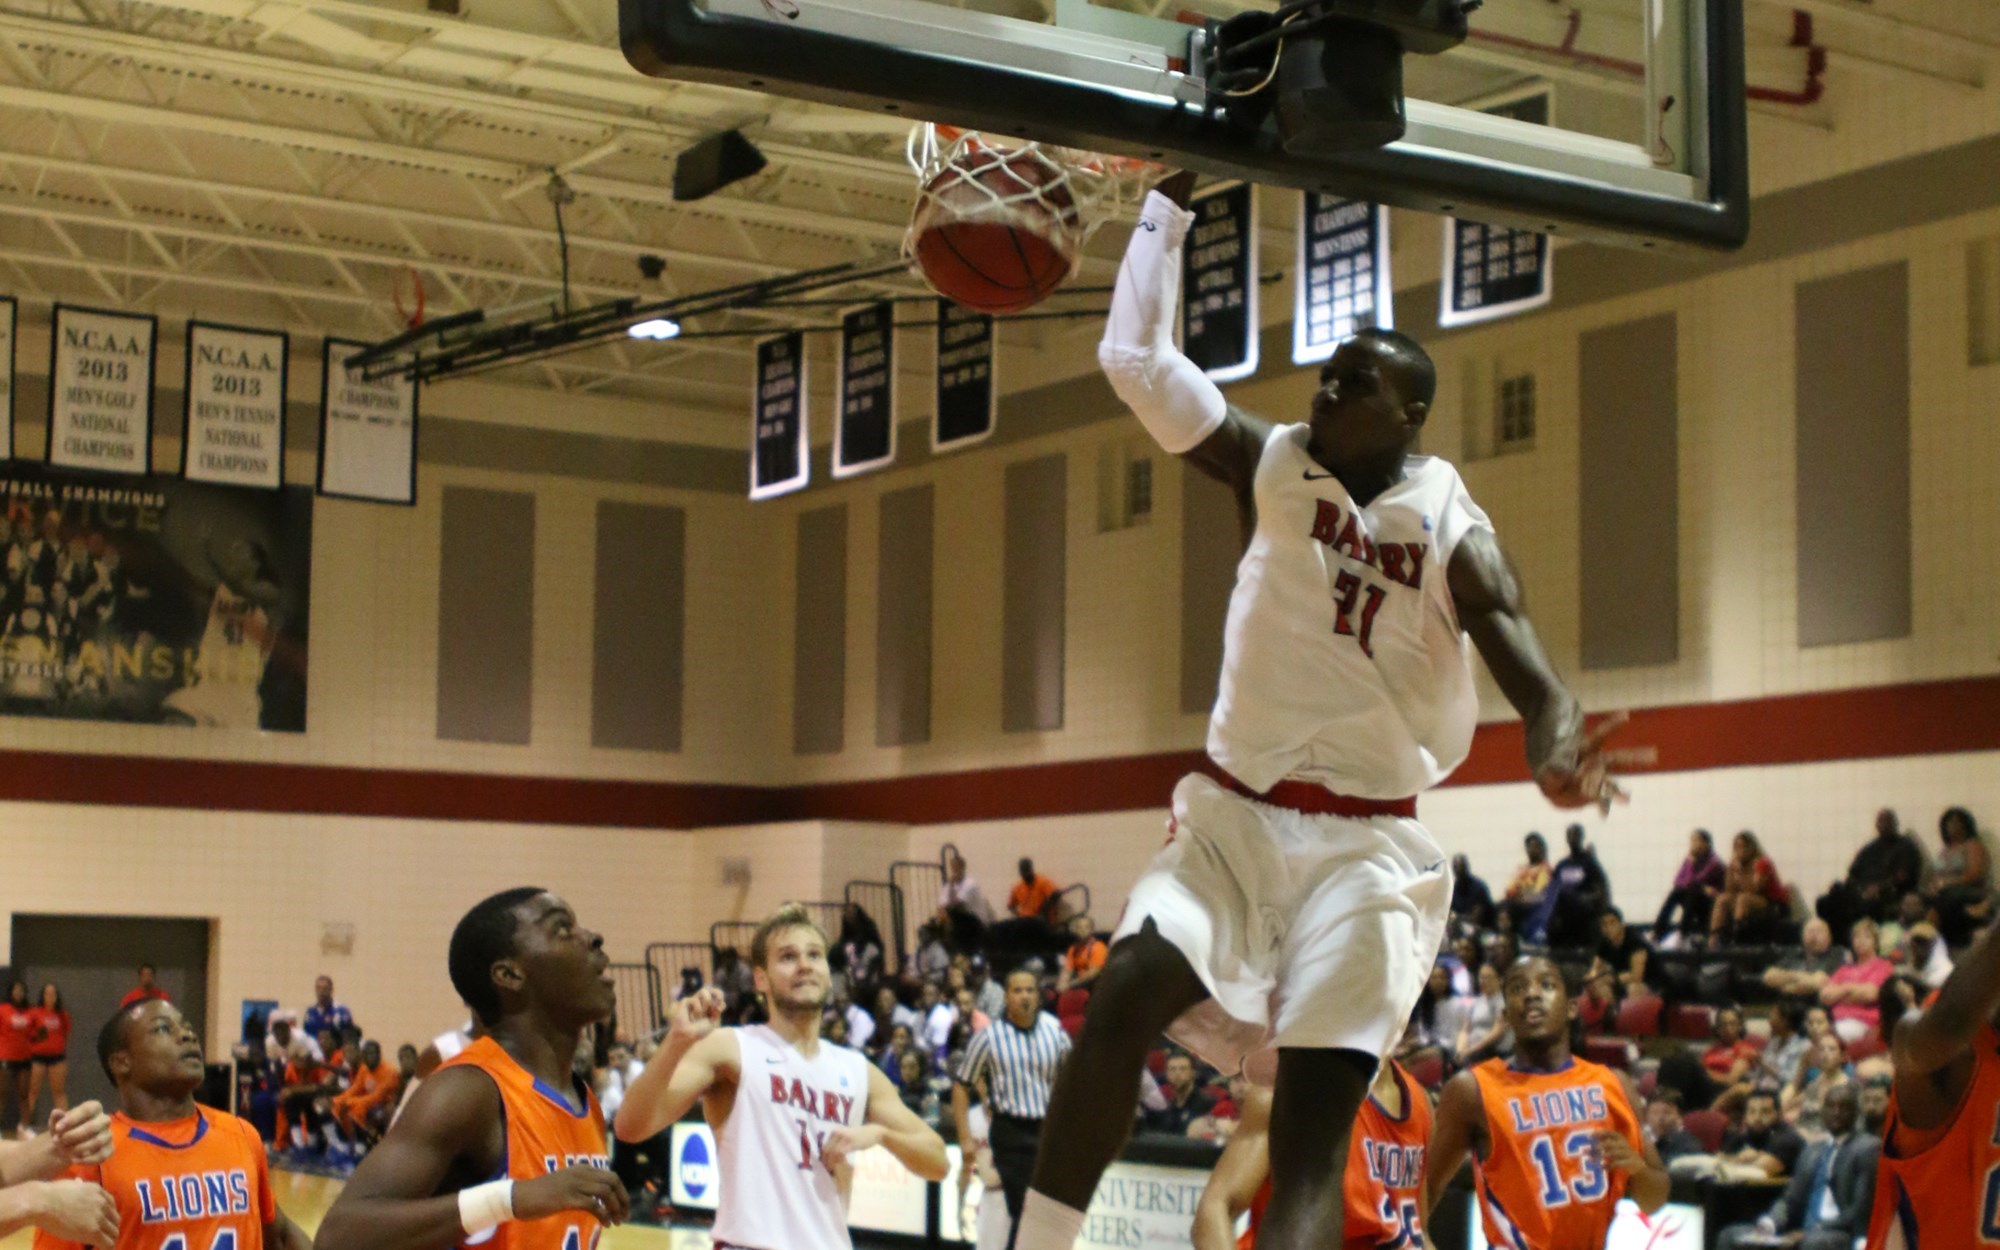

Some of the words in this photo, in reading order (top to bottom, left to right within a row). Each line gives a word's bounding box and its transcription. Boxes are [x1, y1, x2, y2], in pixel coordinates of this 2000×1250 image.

[64, 326, 146, 357] N.C.A.A.
[198, 343, 278, 372] N.C.A.A.
[77, 358, 129, 383] 2013
[67, 386, 103, 405] MEN'S
[105, 390, 138, 410] GOLF
[212, 373, 261, 398] 2013
[71, 412, 131, 435] NATIONAL
[197, 401, 230, 421] MEN'S
[234, 404, 277, 425] TENNIS
[63, 436, 135, 461] CHAMPIONS
[204, 426, 263, 449] NATIONAL
[199, 452, 270, 475] CHAMPIONS
[62, 485, 165, 508] CHAMPIONS
[1310, 498, 1429, 591] BARRY
[769, 1072, 854, 1126] BARRY
[1508, 1083, 1607, 1134] LIONS
[1530, 1129, 1609, 1209] 13
[135, 1168, 249, 1224] LIONS
[1080, 1214, 1142, 1248] EERS
